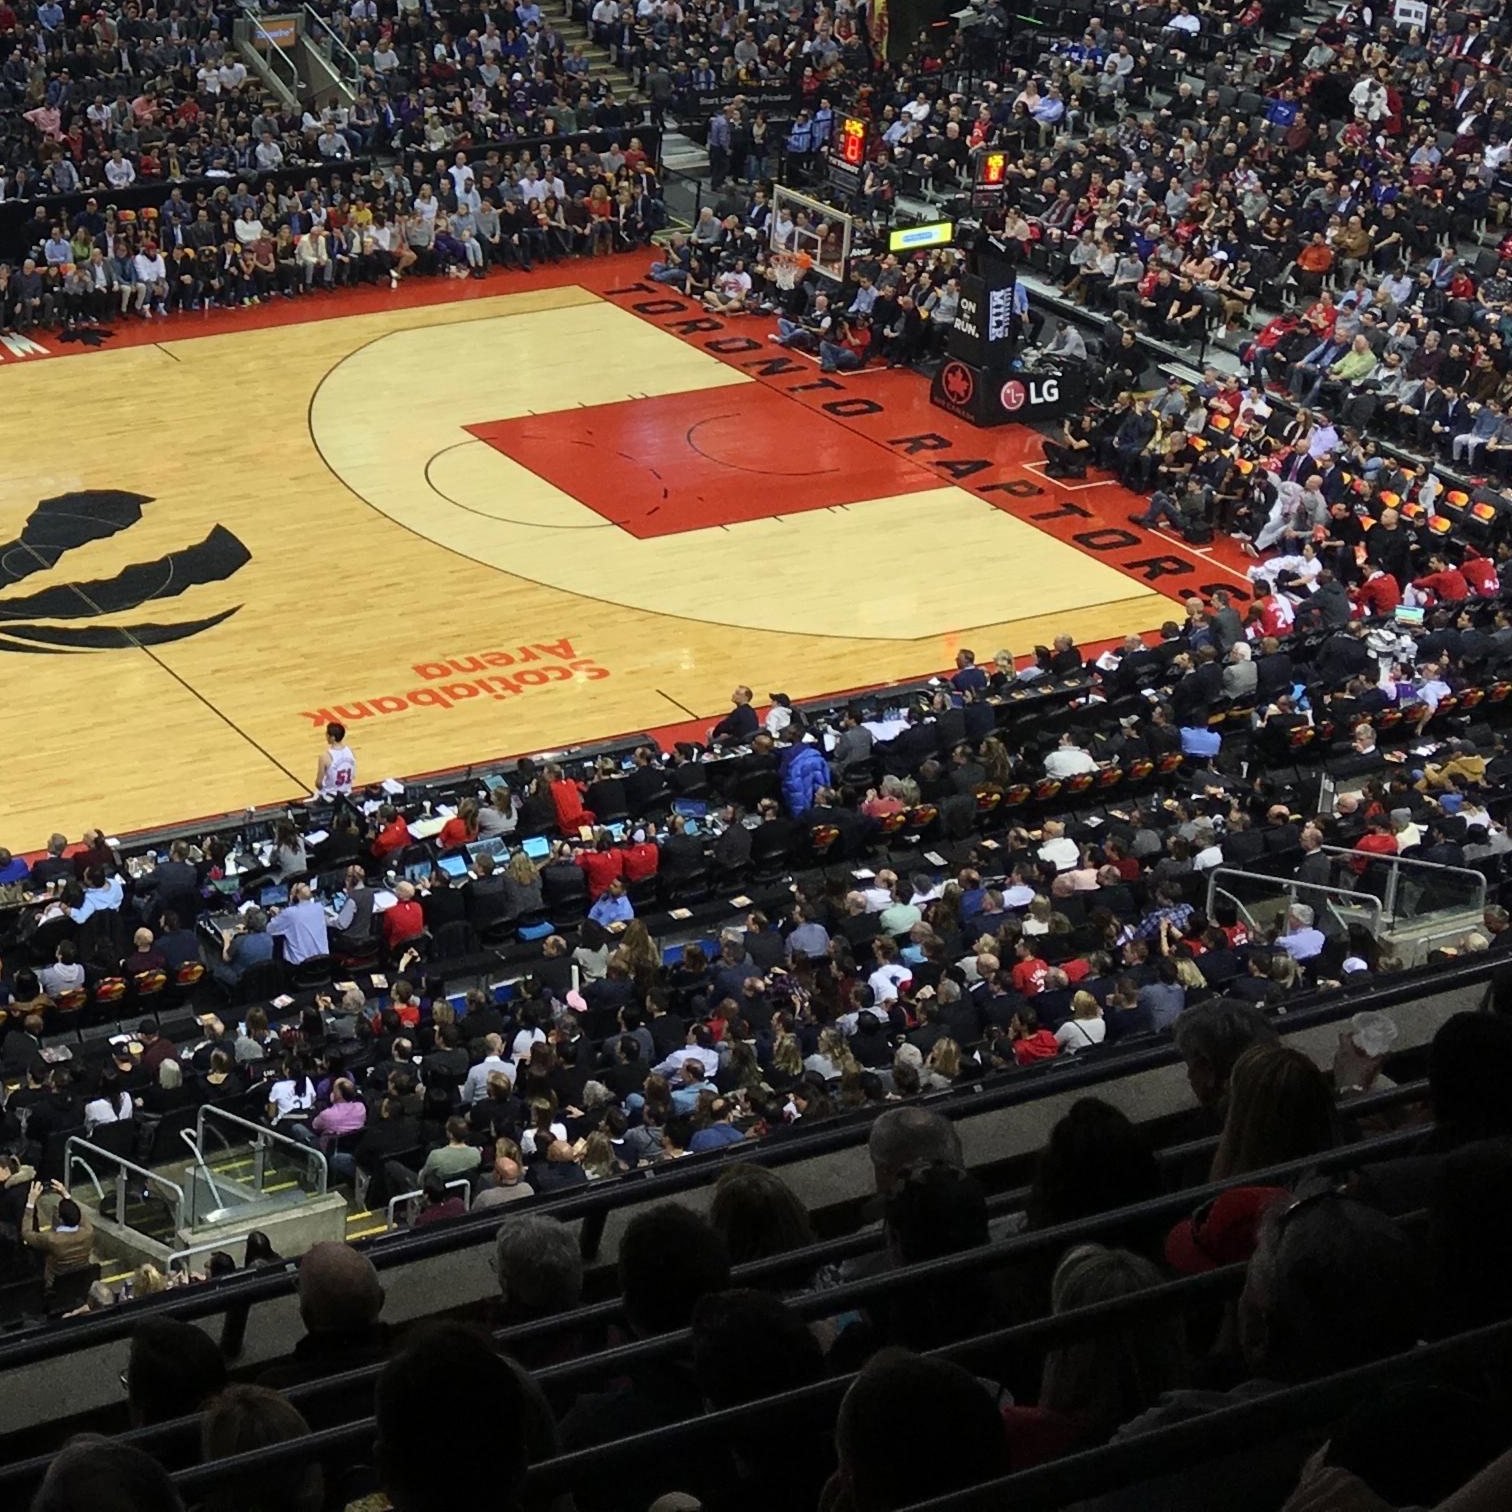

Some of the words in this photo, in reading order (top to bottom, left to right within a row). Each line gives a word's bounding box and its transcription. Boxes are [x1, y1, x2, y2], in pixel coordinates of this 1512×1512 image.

[960, 298, 977, 314] ON
[602, 281, 884, 418] TORONTO
[1029, 379, 1060, 405] LG
[411, 638, 578, 680] Arena
[297, 658, 611, 729] Scotiabank
[335, 767, 352, 786] 51
